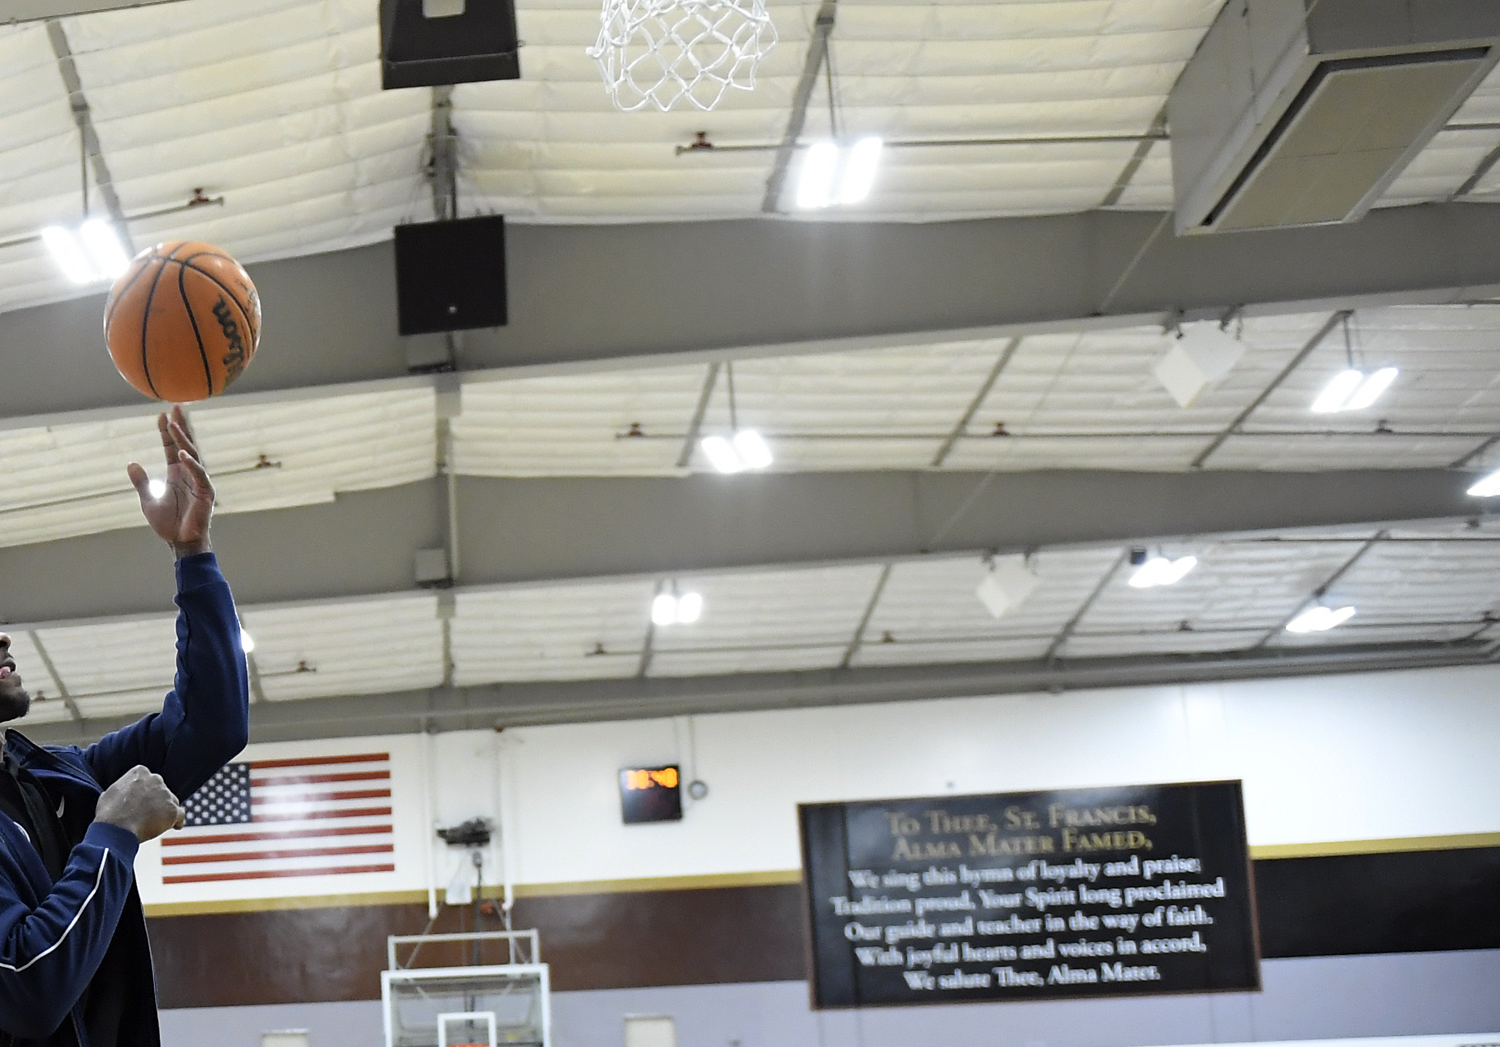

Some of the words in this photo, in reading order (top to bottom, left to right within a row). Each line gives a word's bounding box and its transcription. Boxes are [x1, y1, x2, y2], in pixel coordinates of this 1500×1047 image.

[848, 869, 879, 889] We
[882, 869, 922, 892] sing
[922, 865, 957, 886] this
[959, 864, 1013, 889] hymn
[1016, 859, 1039, 881] of
[1040, 858, 1100, 884] loyalty
[1103, 855, 1140, 877] and
[829, 895, 911, 916] Tradition
[1025, 886, 1077, 911] Spirit
[1078, 884, 1123, 908] long
[1124, 877, 1225, 907] proclaimed
[844, 921, 882, 941] Our
[885, 918, 936, 945] guide
[938, 915, 974, 937] and
[977, 913, 1043, 936] teacher
[1044, 913, 1066, 932] in
[1068, 910, 1100, 932] the
[1101, 913, 1139, 934] way
[1141, 905, 1165, 928] of
[855, 945, 904, 966] With
[906, 942, 959, 969] joyful
[961, 941, 1017, 962] hearts
[1019, 938, 1055, 960] and
[1057, 938, 1114, 958] voices
[1116, 936, 1138, 955] in
[903, 970, 936, 990] We
[937, 968, 991, 990] salute
[1047, 963, 1098, 985] Alma
